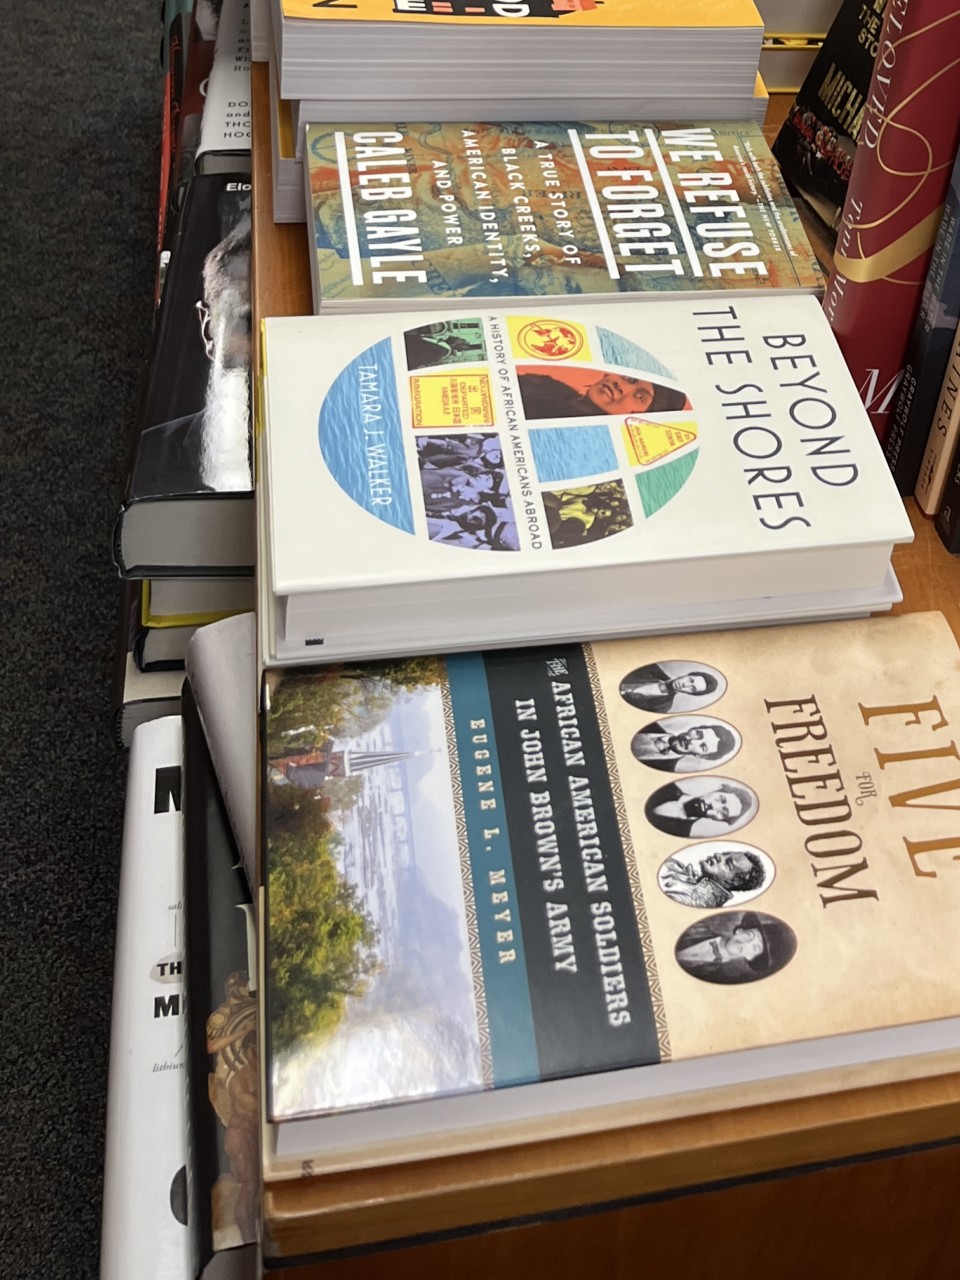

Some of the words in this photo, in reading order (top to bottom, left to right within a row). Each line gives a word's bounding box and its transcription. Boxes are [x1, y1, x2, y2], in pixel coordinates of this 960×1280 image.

[352, 130, 413, 200] CALEB
[432, 160, 450, 182] AND
[501, 147, 524, 188] BLACK
[533, 140, 544, 150] A
[538, 153, 559, 189] TRUE
[585, 130, 645, 161] TO
[661, 127, 723, 162] WE
[438, 183, 464, 246] POWER
[462, 130, 486, 202] AMERICAN
[478, 204, 509, 285] IDENTITY,
[511, 189, 541, 260] CREEKS,
[548, 192, 576, 242] STORY
[599, 171, 685, 278] FORGET
[677, 171, 769, 278] REFUSE
[363, 211, 428, 285] GAYLE
[563, 244, 582, 265] OF
[488, 315, 498, 323] A
[490, 324, 506, 366] HISTORY
[692, 306, 753, 365] THE
[356, 361, 384, 427] TAMARA
[413, 378, 423, 426] IMMIGRATION
[459, 381, 470, 420] DEPARTED
[499, 368, 510, 383] OF
[366, 428, 383, 440] J.
[502, 385, 518, 430] AFRICAN
[763, 333, 859, 488] BEYOND
[368, 442, 393, 509] WALKER
[510, 431, 531, 497] AMERICANS
[715, 381, 812, 531] SHORES
[523, 501, 542, 550] ABROAD
[515, 698, 536, 715] IN
[520, 725, 547, 783] JOHN
[764, 693, 880, 909] FREEDOM
[854, 771, 878, 806] FOR
[469, 718, 496, 810] EUGENE
[483, 828, 494, 852] L.
[489, 869, 517, 966] MEYER
[529, 788, 565, 888] BROWN'S
[552, 681, 586, 767] AFRICAN
[569, 775, 608, 893] AMERICAN
[591, 900, 632, 1029] SOLDIERS
[546, 901, 578, 974] ARMY
